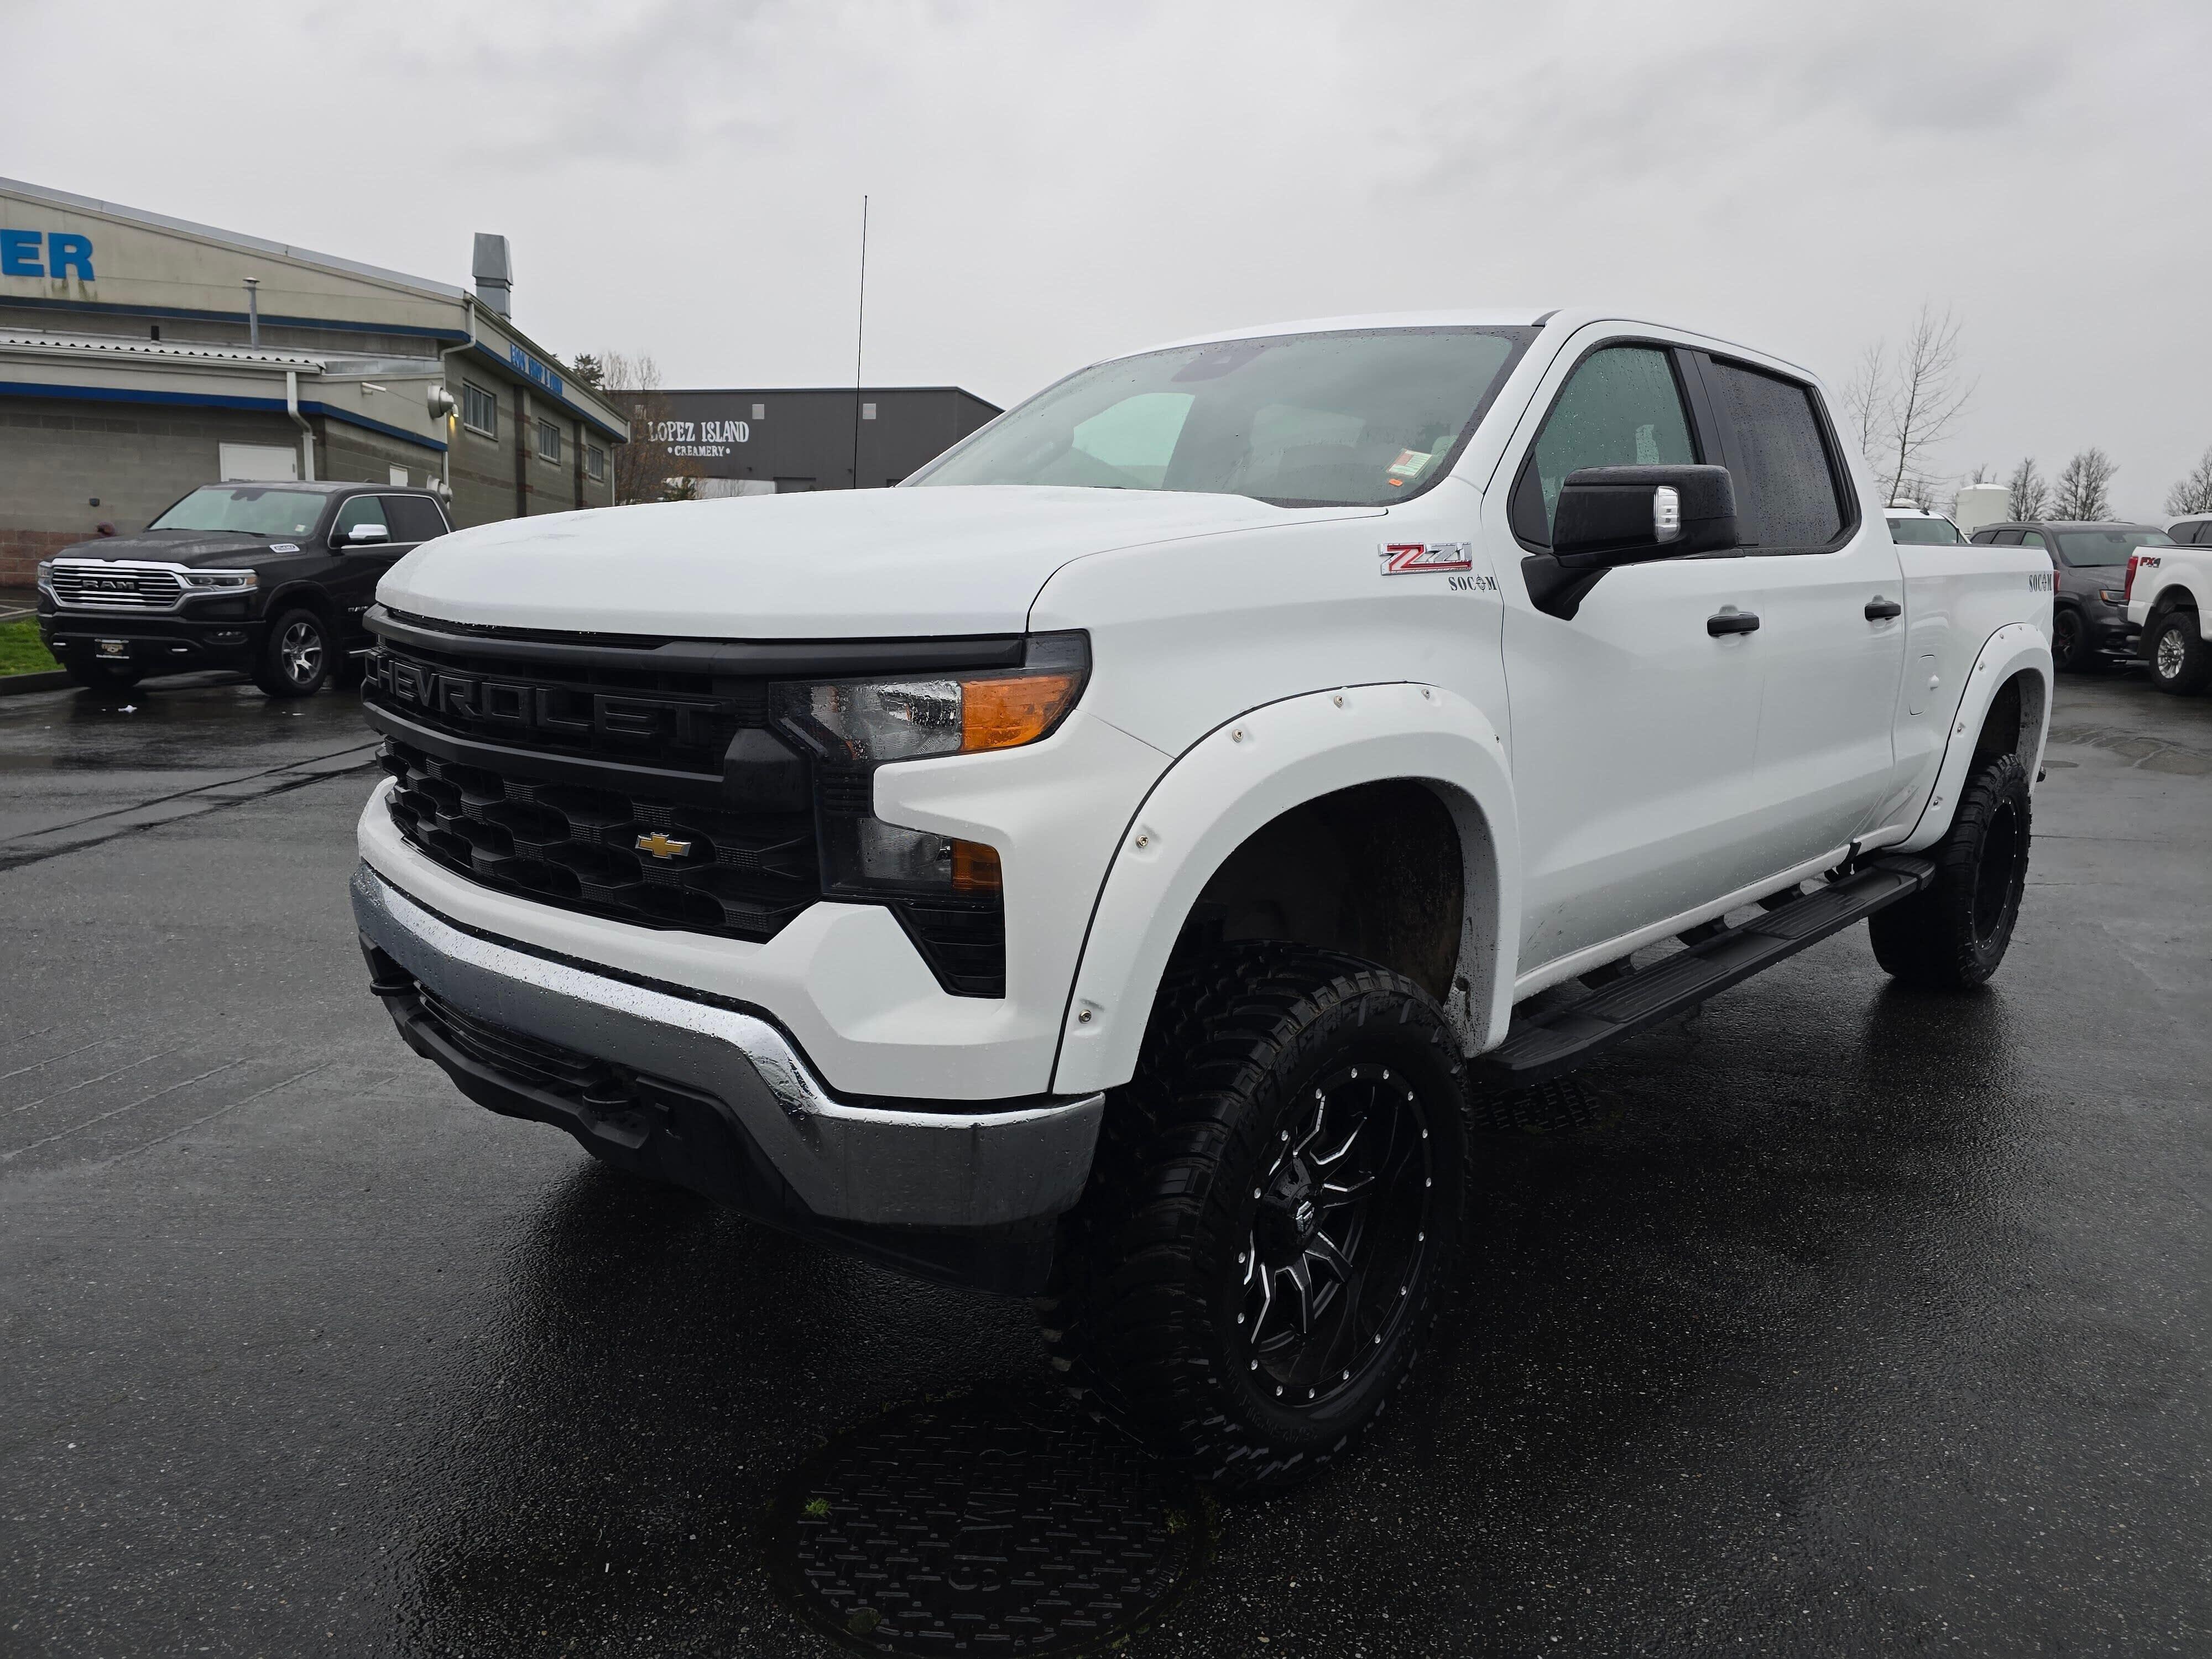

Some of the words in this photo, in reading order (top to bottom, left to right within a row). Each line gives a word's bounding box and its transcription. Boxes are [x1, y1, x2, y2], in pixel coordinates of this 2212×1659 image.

[0, 229, 95, 281] ER
[648, 421, 696, 442] LOPEZ
[701, 420, 749, 442] ISLAND
[674, 445, 725, 457] CREAMERY
[1378, 541, 1473, 576] Z71
[2140, 556, 2161, 568] FX4
[82, 580, 135, 589] RAM
[364, 651, 722, 744] CHEVROLET
